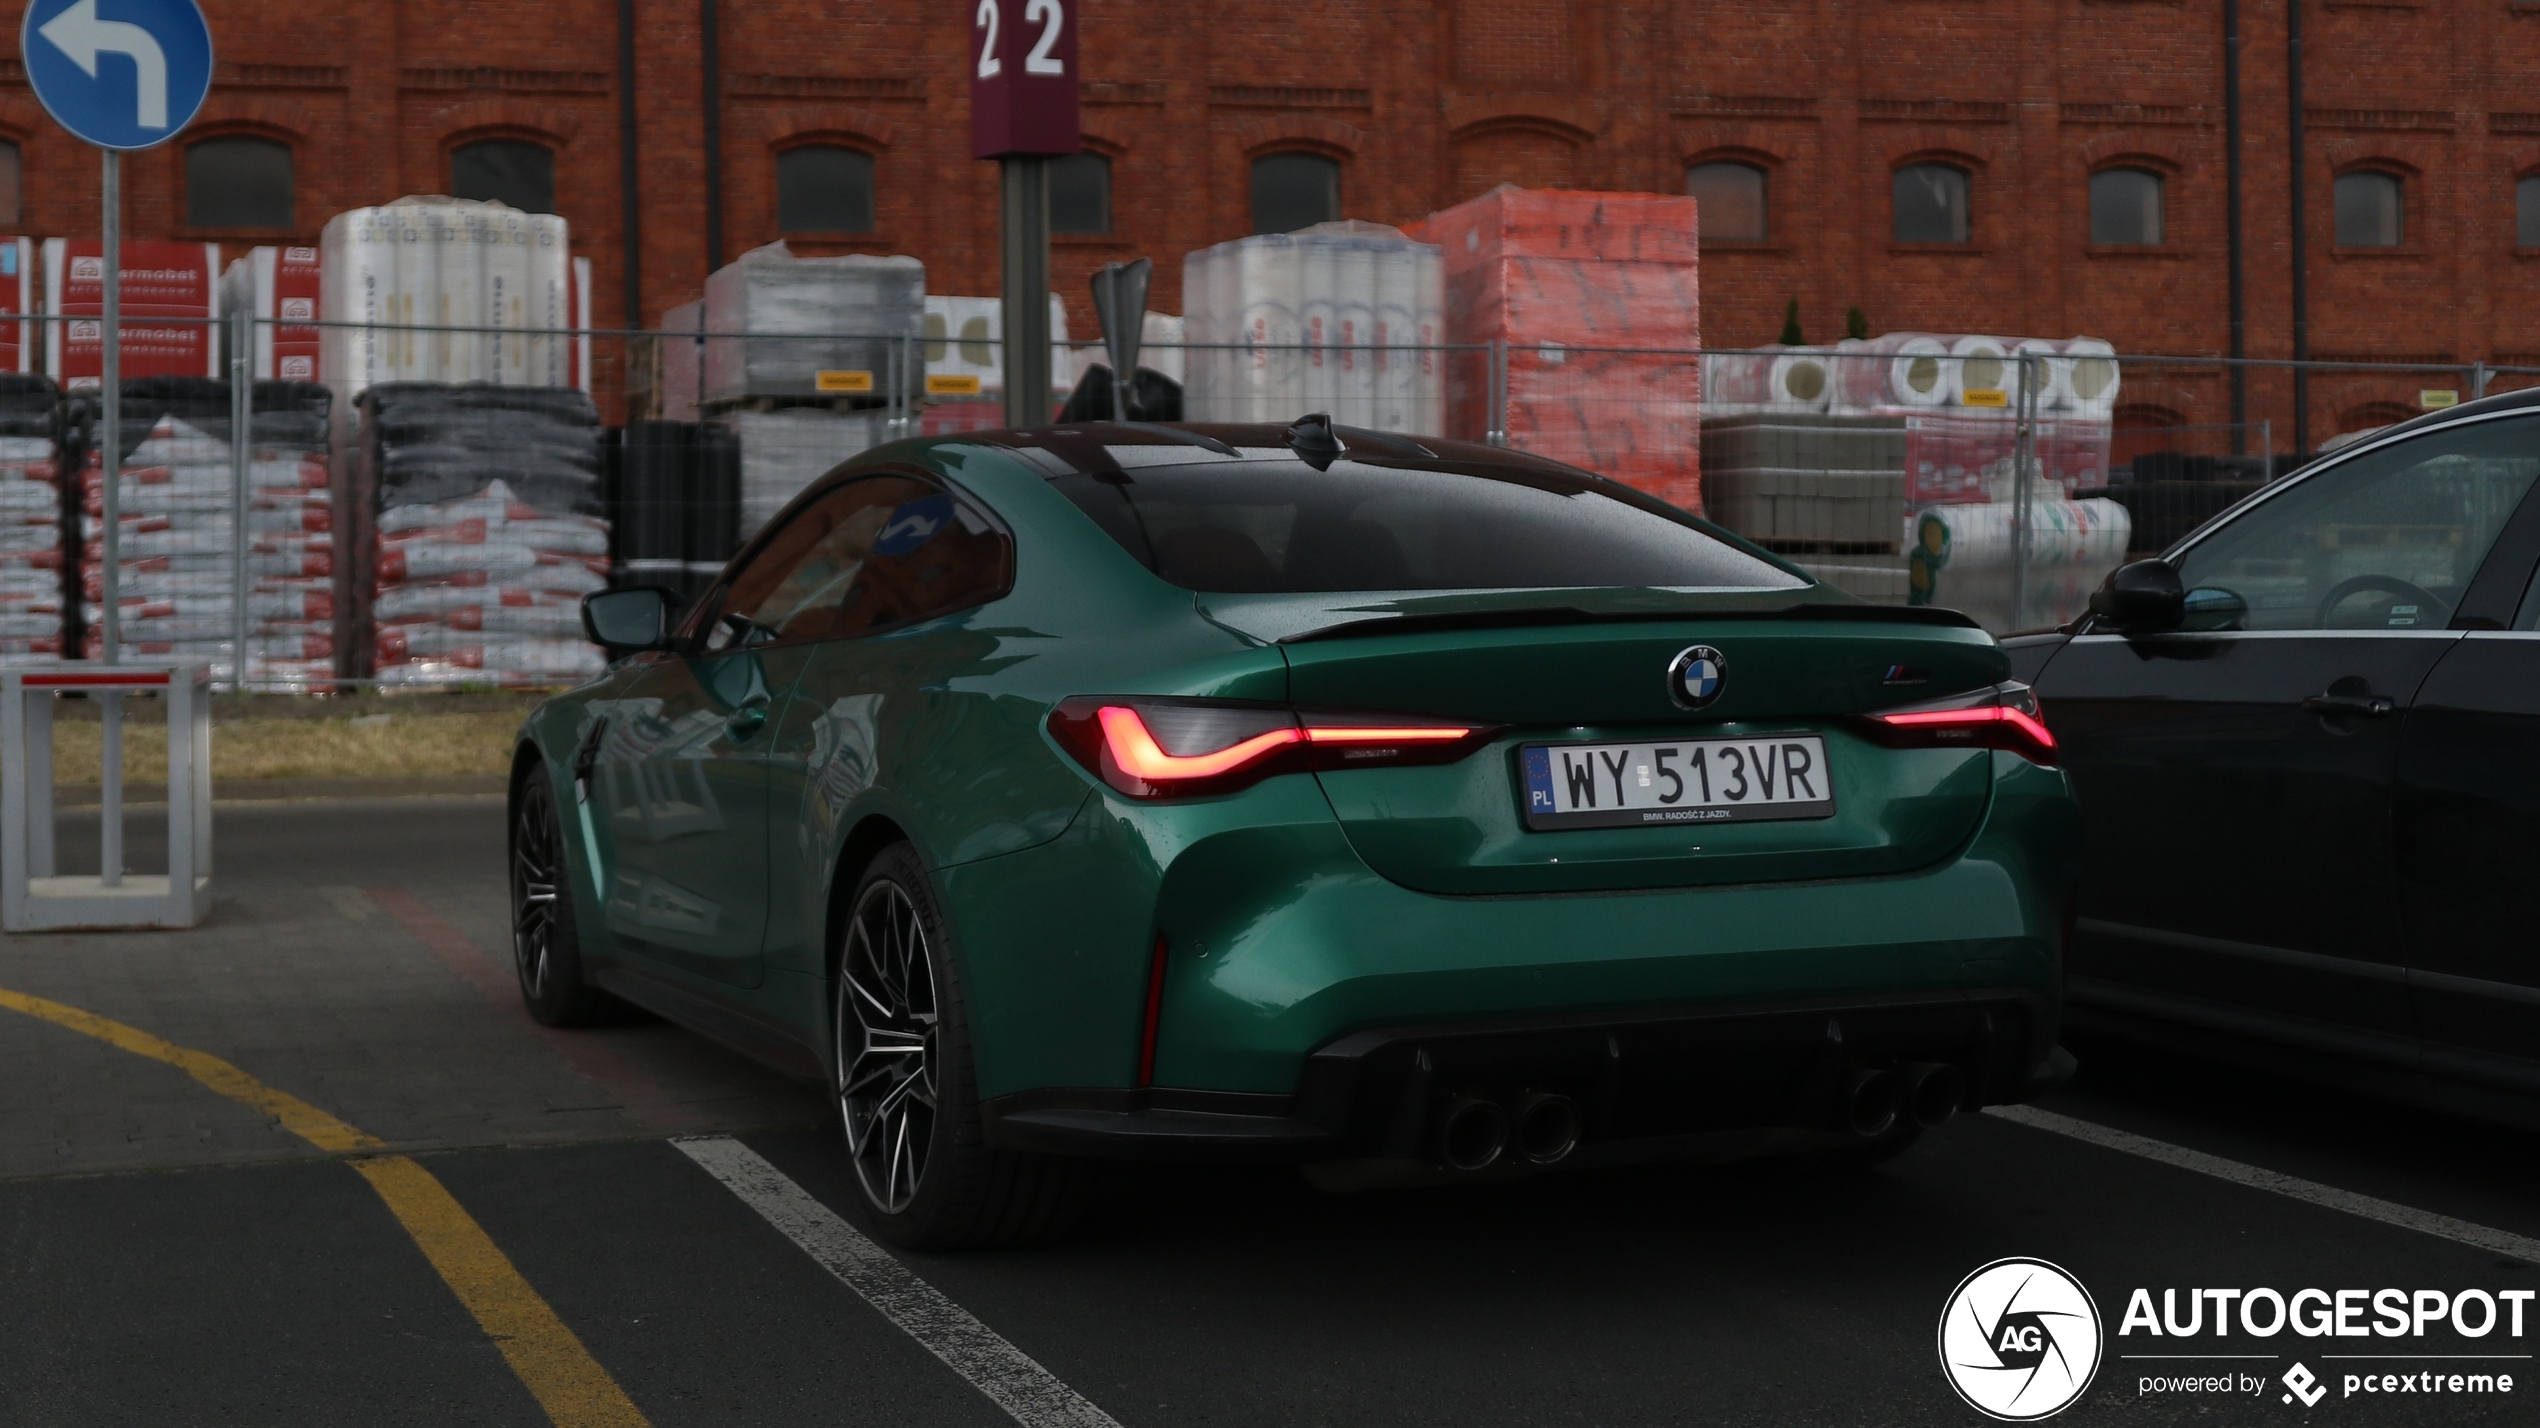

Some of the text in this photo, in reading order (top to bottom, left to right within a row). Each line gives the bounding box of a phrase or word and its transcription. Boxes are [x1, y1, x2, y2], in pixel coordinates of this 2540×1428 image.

[976, 0, 1001, 79] 2
[1025, 0, 1064, 76] 2
[118, 267, 198, 281] ermobet
[69, 284, 103, 294] BETO
[117, 327, 198, 341] ermobet
[67, 344, 103, 354] BETO
[1680, 648, 1724, 669] BMW
[1562, 743, 1816, 808] WY 513VR
[1532, 790, 1552, 806] PL
[1699, 810, 1705, 819] Z
